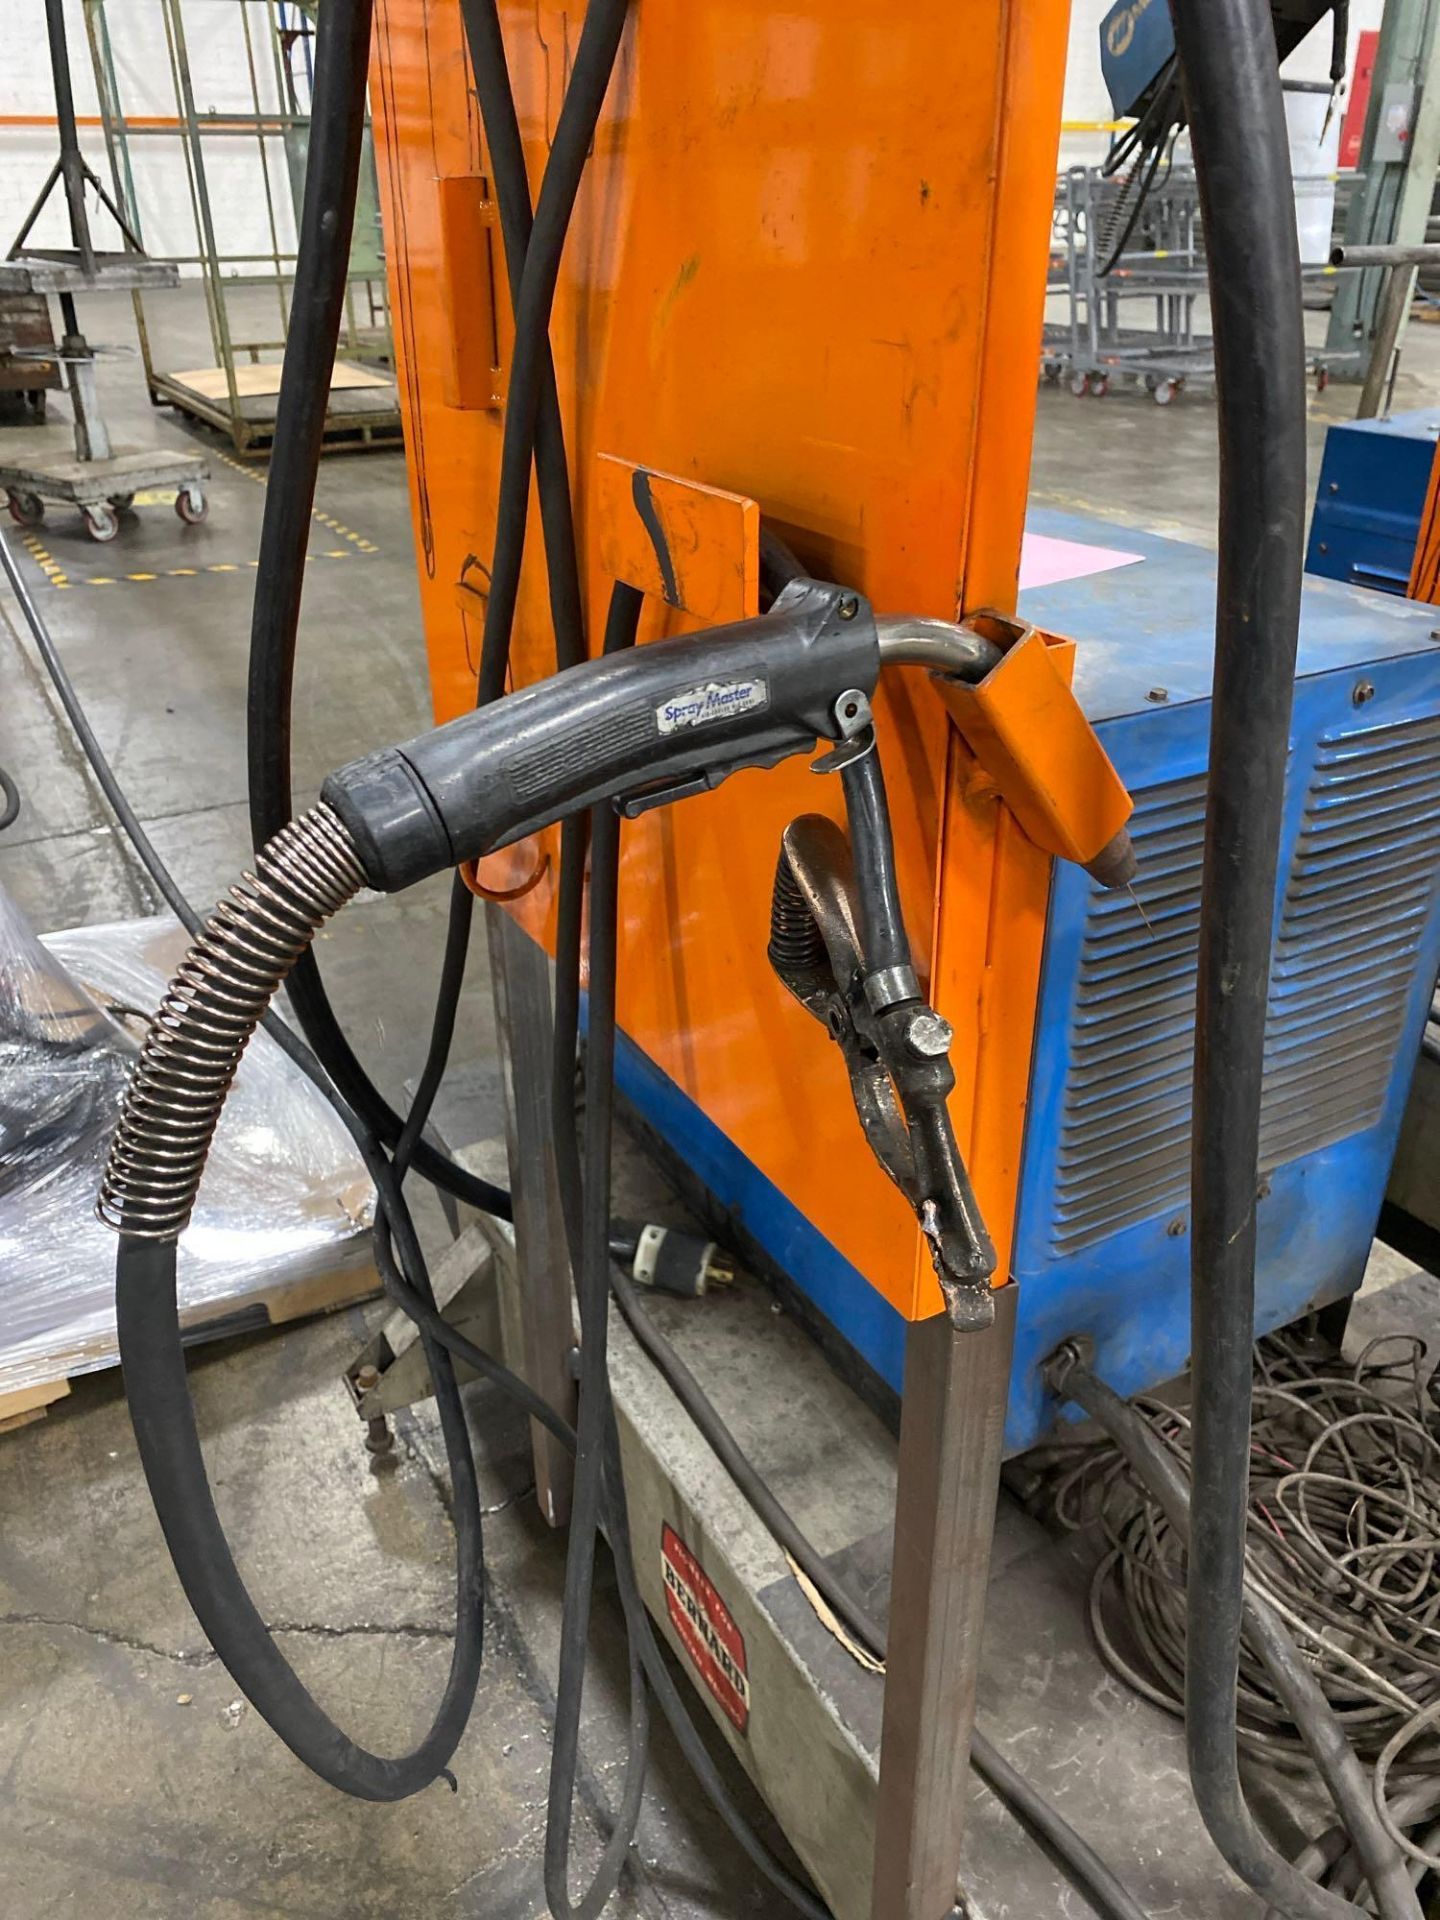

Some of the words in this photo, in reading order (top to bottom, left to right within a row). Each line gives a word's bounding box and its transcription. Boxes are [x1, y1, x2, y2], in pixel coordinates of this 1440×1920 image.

[665, 700, 704, 722] Spray
[706, 687, 752, 709] Master
[666, 1562, 745, 1696] BERNARD
